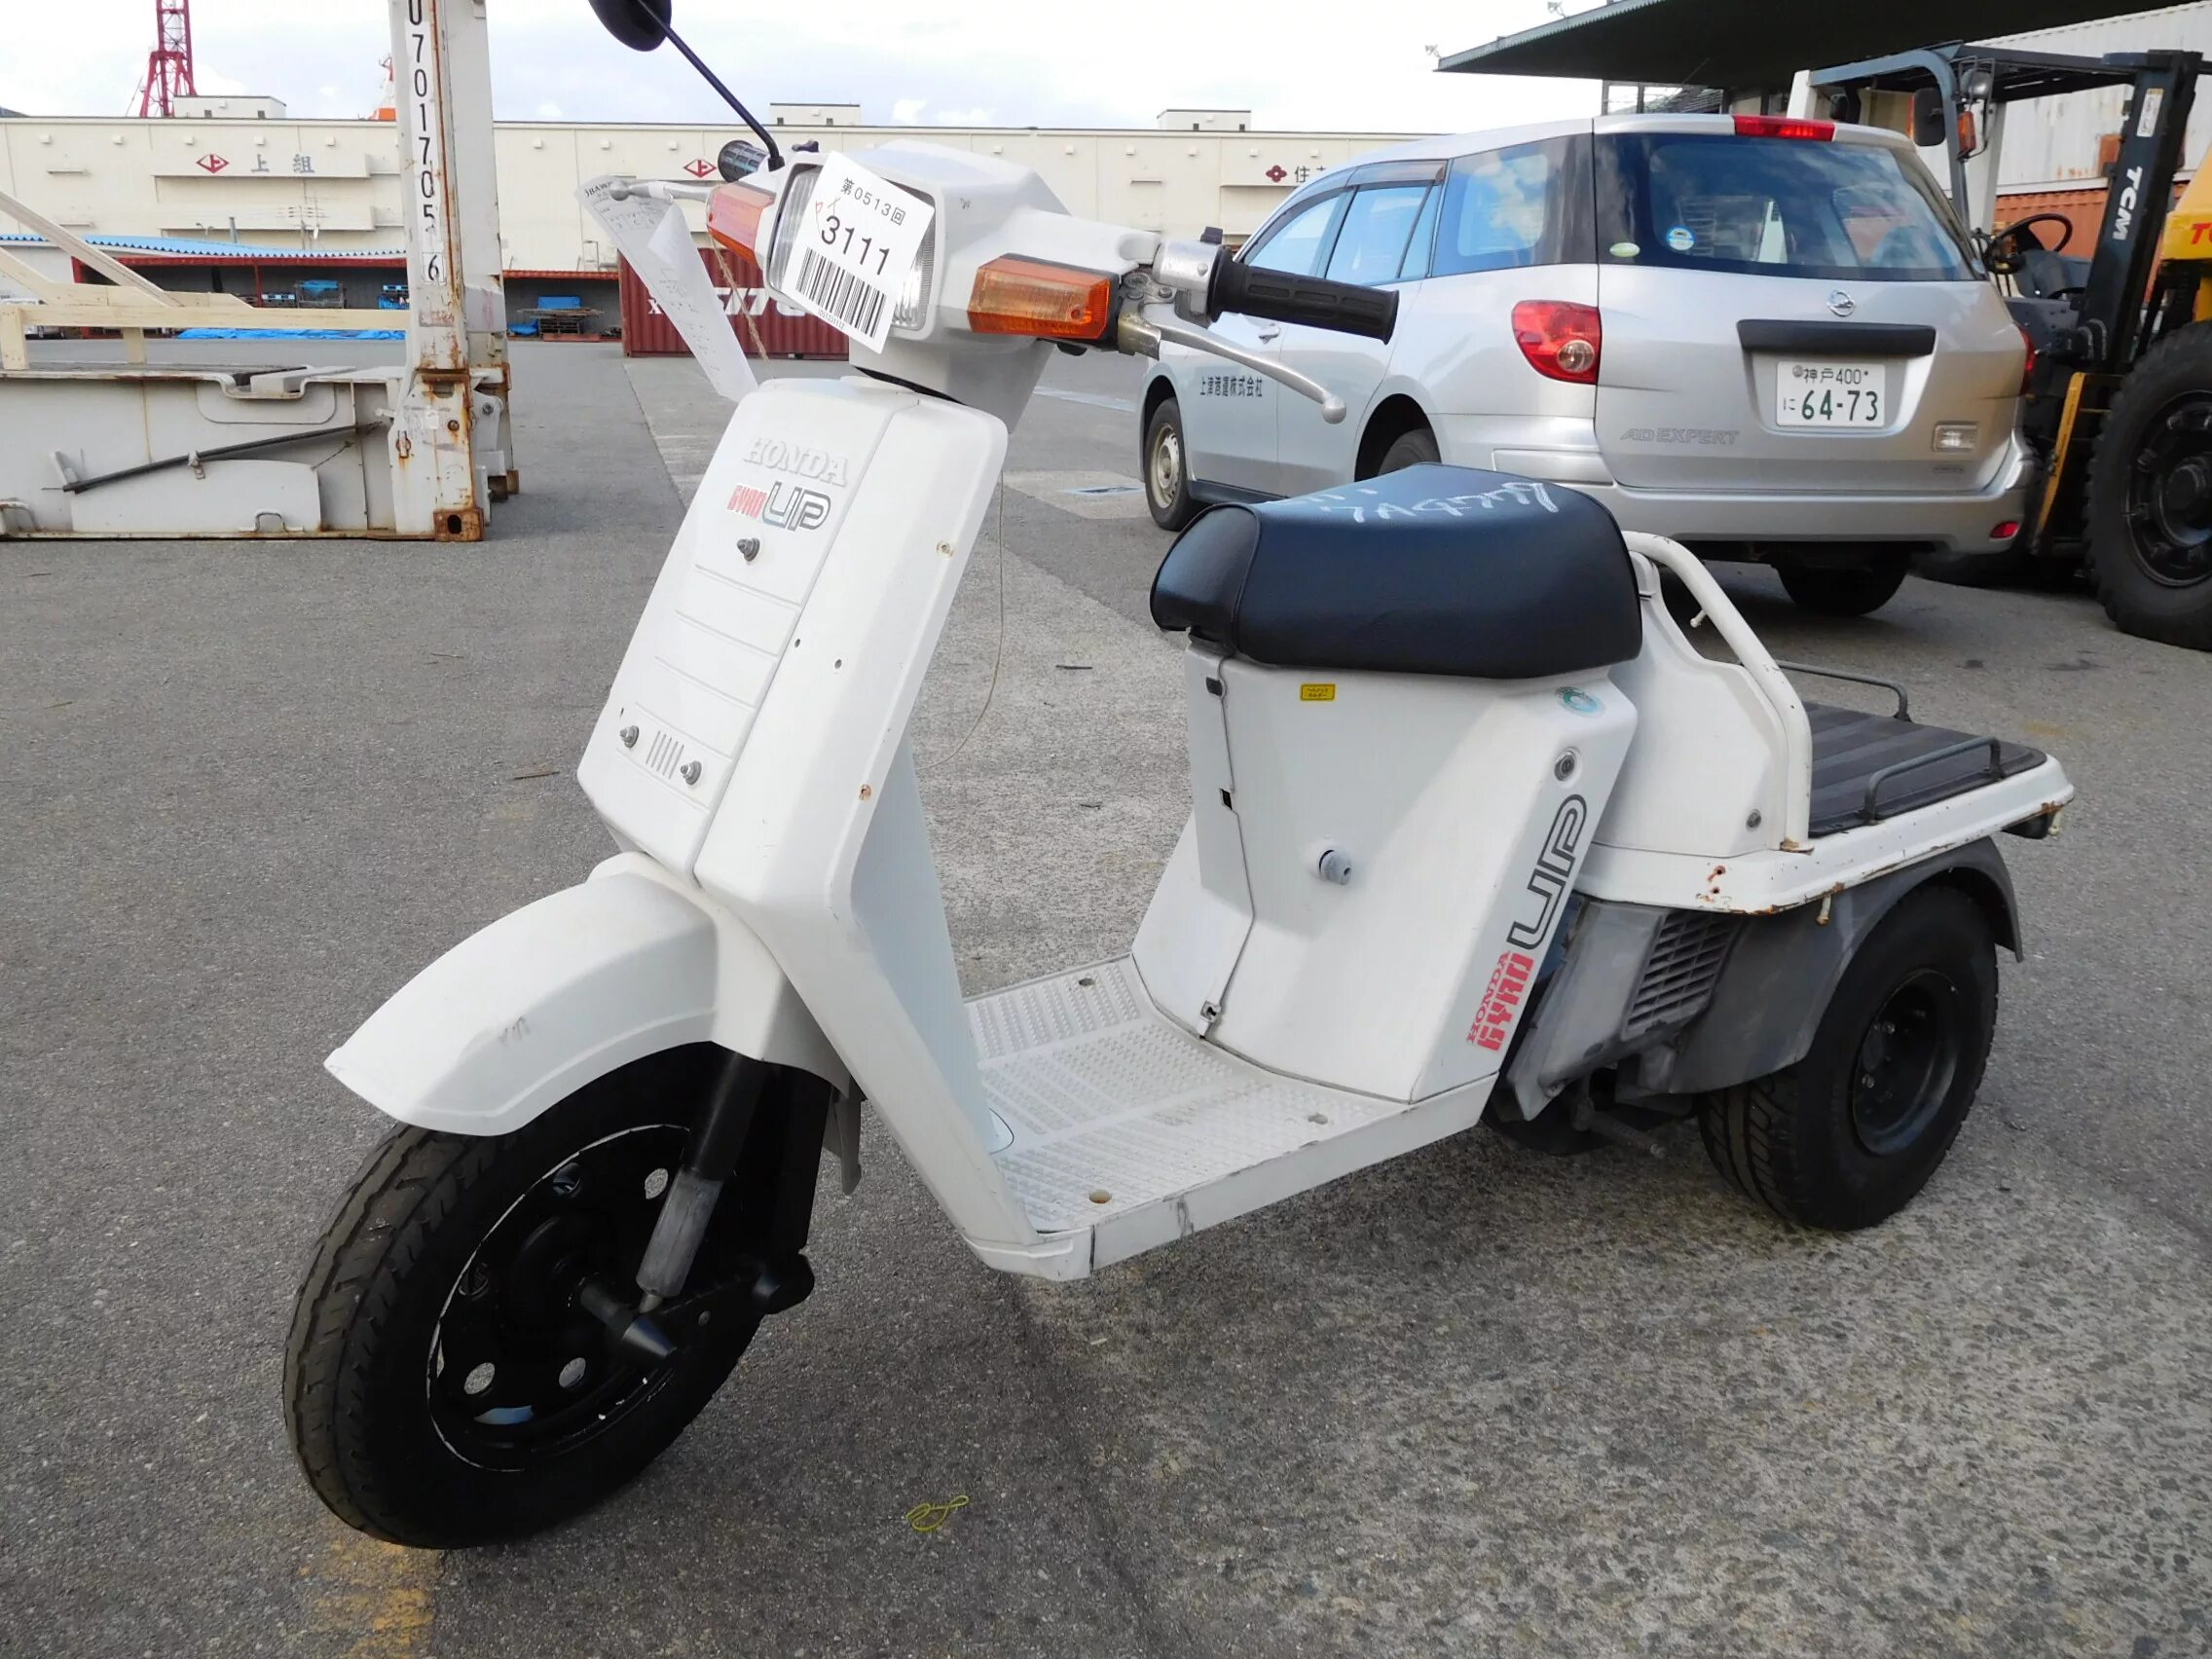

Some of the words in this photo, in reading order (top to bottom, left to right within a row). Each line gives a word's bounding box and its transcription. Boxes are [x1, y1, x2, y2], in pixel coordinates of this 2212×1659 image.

[840, 177, 906, 226] 第0513回
[2113, 166, 2143, 240] TCM
[821, 215, 890, 276] 3111
[2191, 222, 2212, 245] T
[1801, 389, 1878, 422] 64-73
[1619, 427, 1655, 442] AD
[1656, 427, 1740, 445] EXPERT
[743, 437, 849, 488] HONDA
[761, 480, 831, 532] UP
[1477, 951, 1534, 1051] GYRO
[1506, 793, 1587, 950] UP
[1467, 950, 1511, 1044] HONDA
